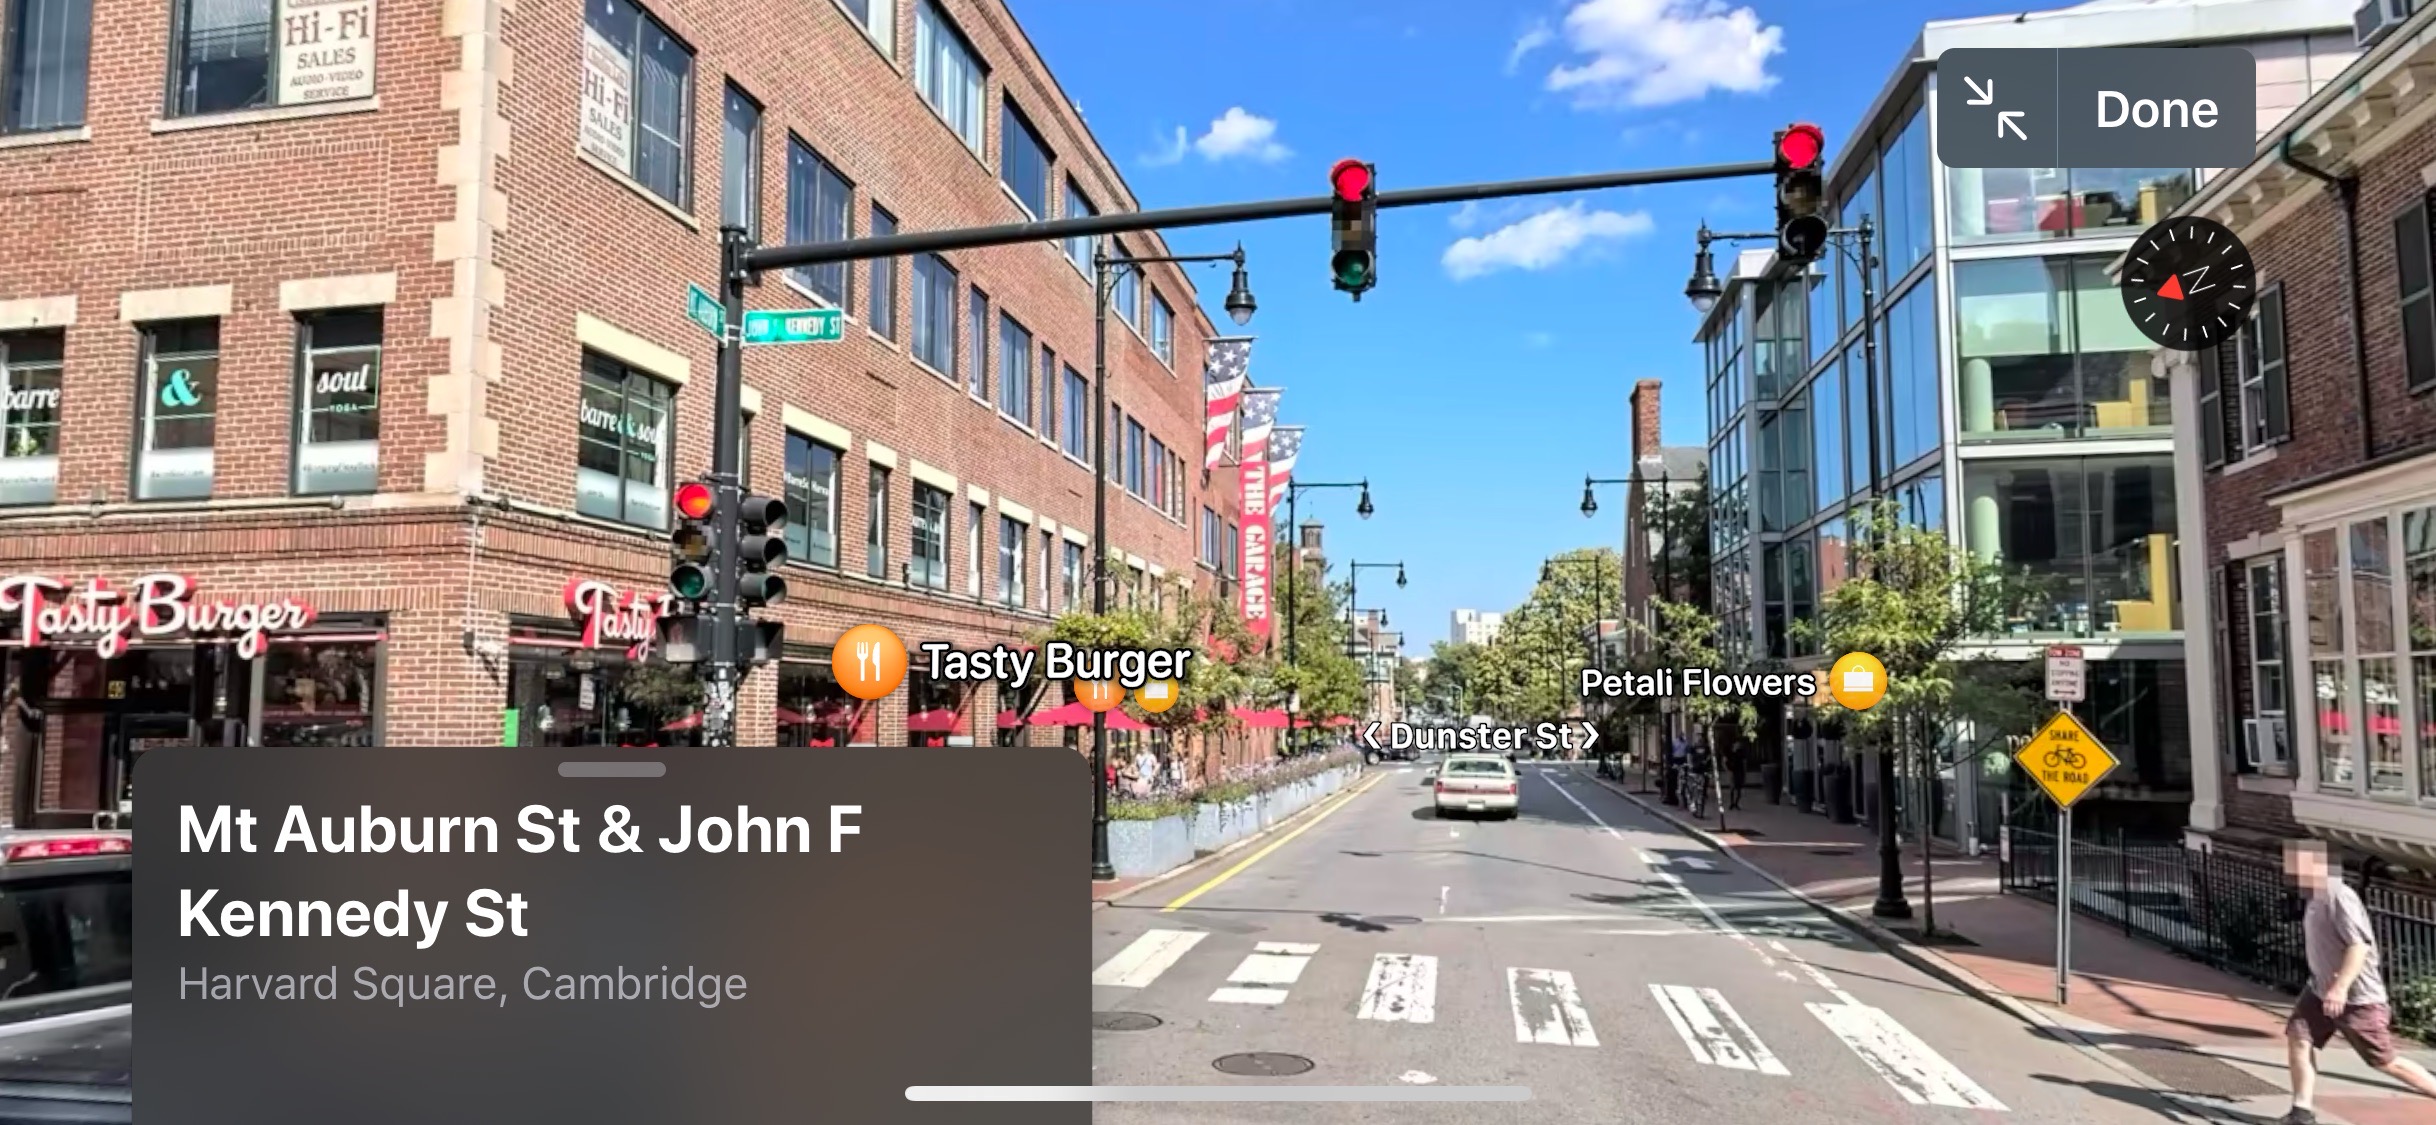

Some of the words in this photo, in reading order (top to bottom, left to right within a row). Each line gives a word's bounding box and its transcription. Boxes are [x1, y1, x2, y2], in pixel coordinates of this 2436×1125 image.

[285, 5, 370, 47] Hi-Fi
[297, 46, 356, 70] SALES
[590, 107, 622, 140] SALES
[829, 316, 840, 336] ST
[2, 385, 61, 410] barre
[161, 368, 203, 407] &
[316, 363, 371, 394] soul
[580, 397, 618, 433] barre
[1244, 465, 1266, 516] THE
[1244, 524, 1267, 620] GARAGE
[0, 574, 134, 659] Tasty
[134, 573, 311, 660] Burger
[574, 579, 655, 662] Tasty
[2050, 729, 2080, 742] SHARE
[2042, 770, 2059, 783] THE
[2063, 771, 2090, 784] ROAD
